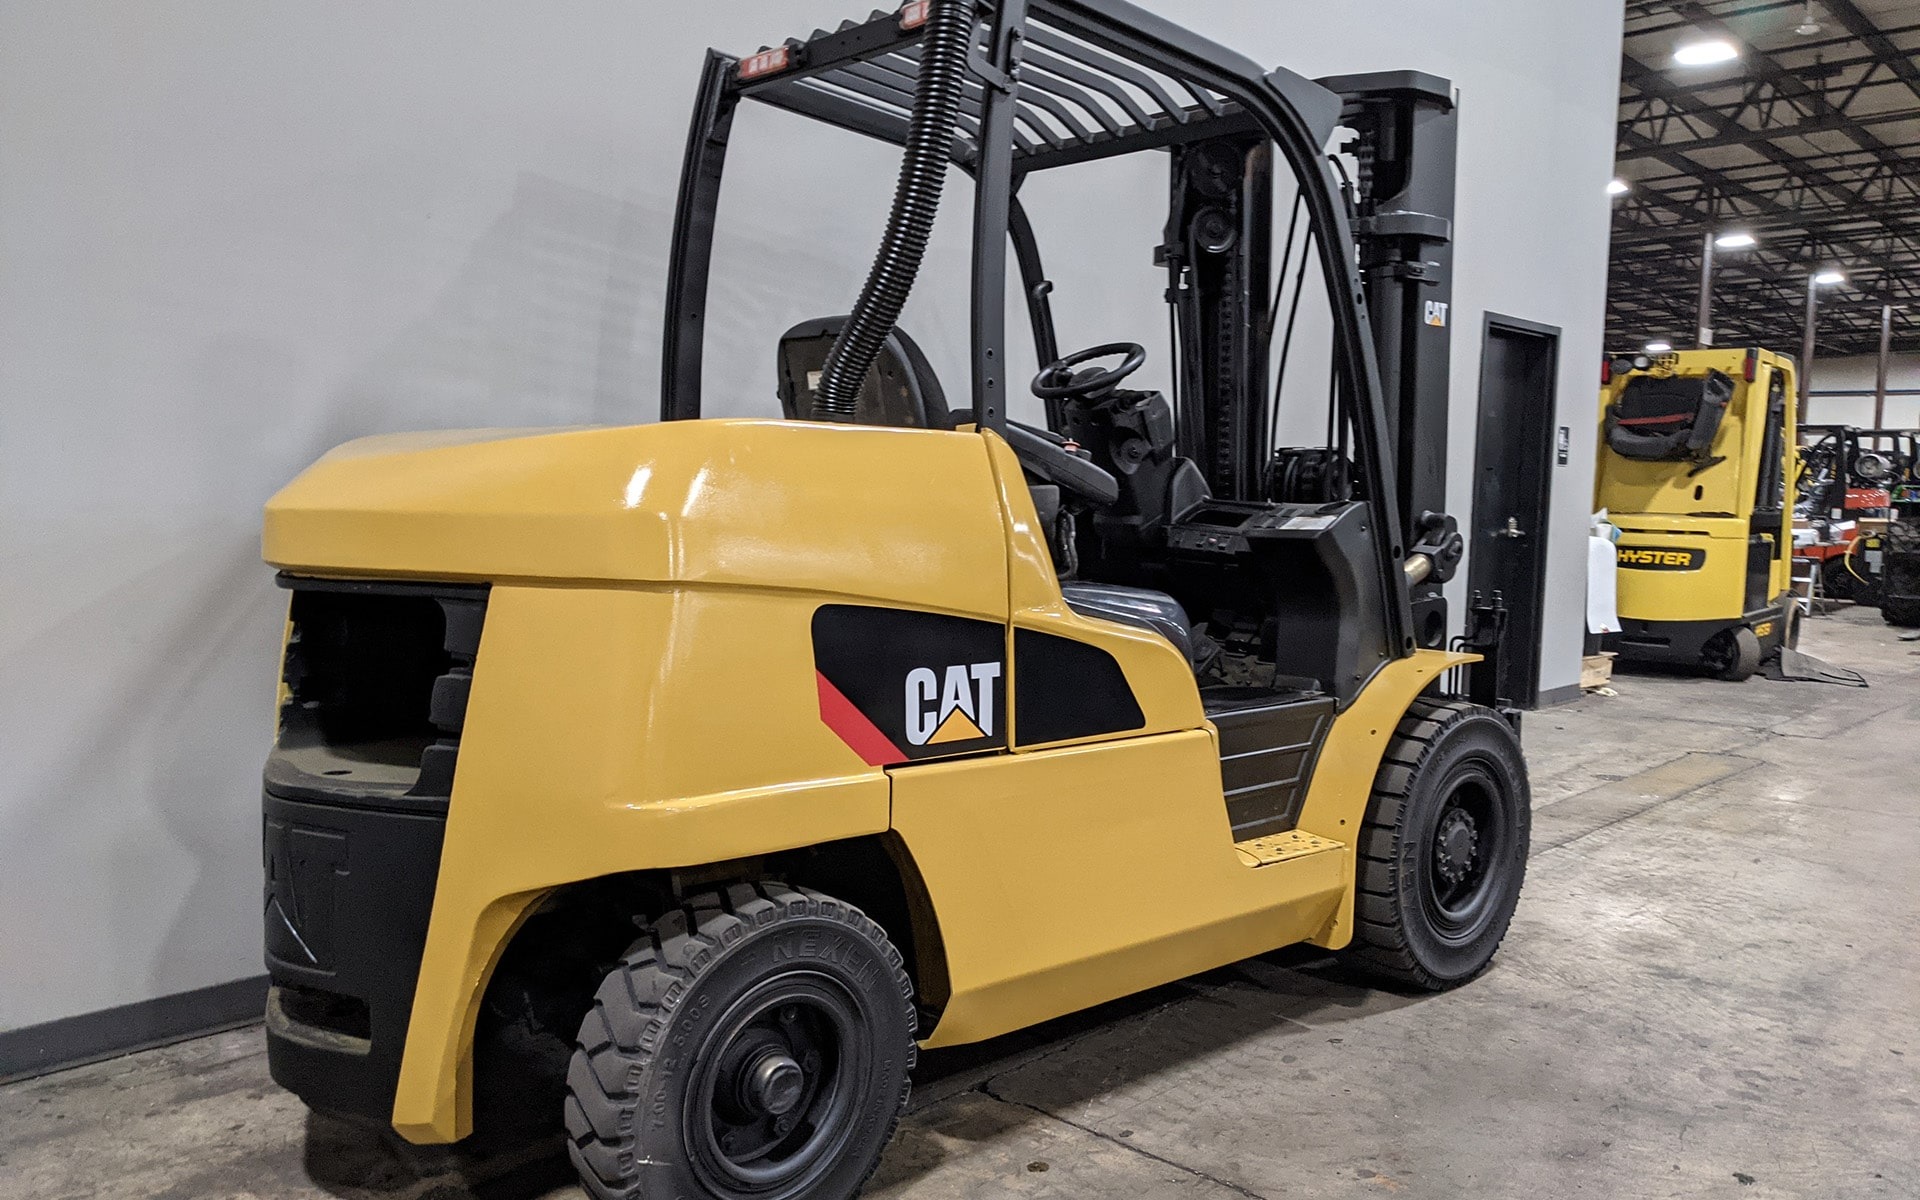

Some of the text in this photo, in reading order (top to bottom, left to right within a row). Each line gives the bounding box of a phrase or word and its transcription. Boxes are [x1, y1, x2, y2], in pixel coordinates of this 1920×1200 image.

[1424, 300, 1448, 327] CAT
[1617, 549, 1692, 566] HYSTER
[904, 661, 1001, 746] CAT
[772, 929, 881, 993] NEXEN
